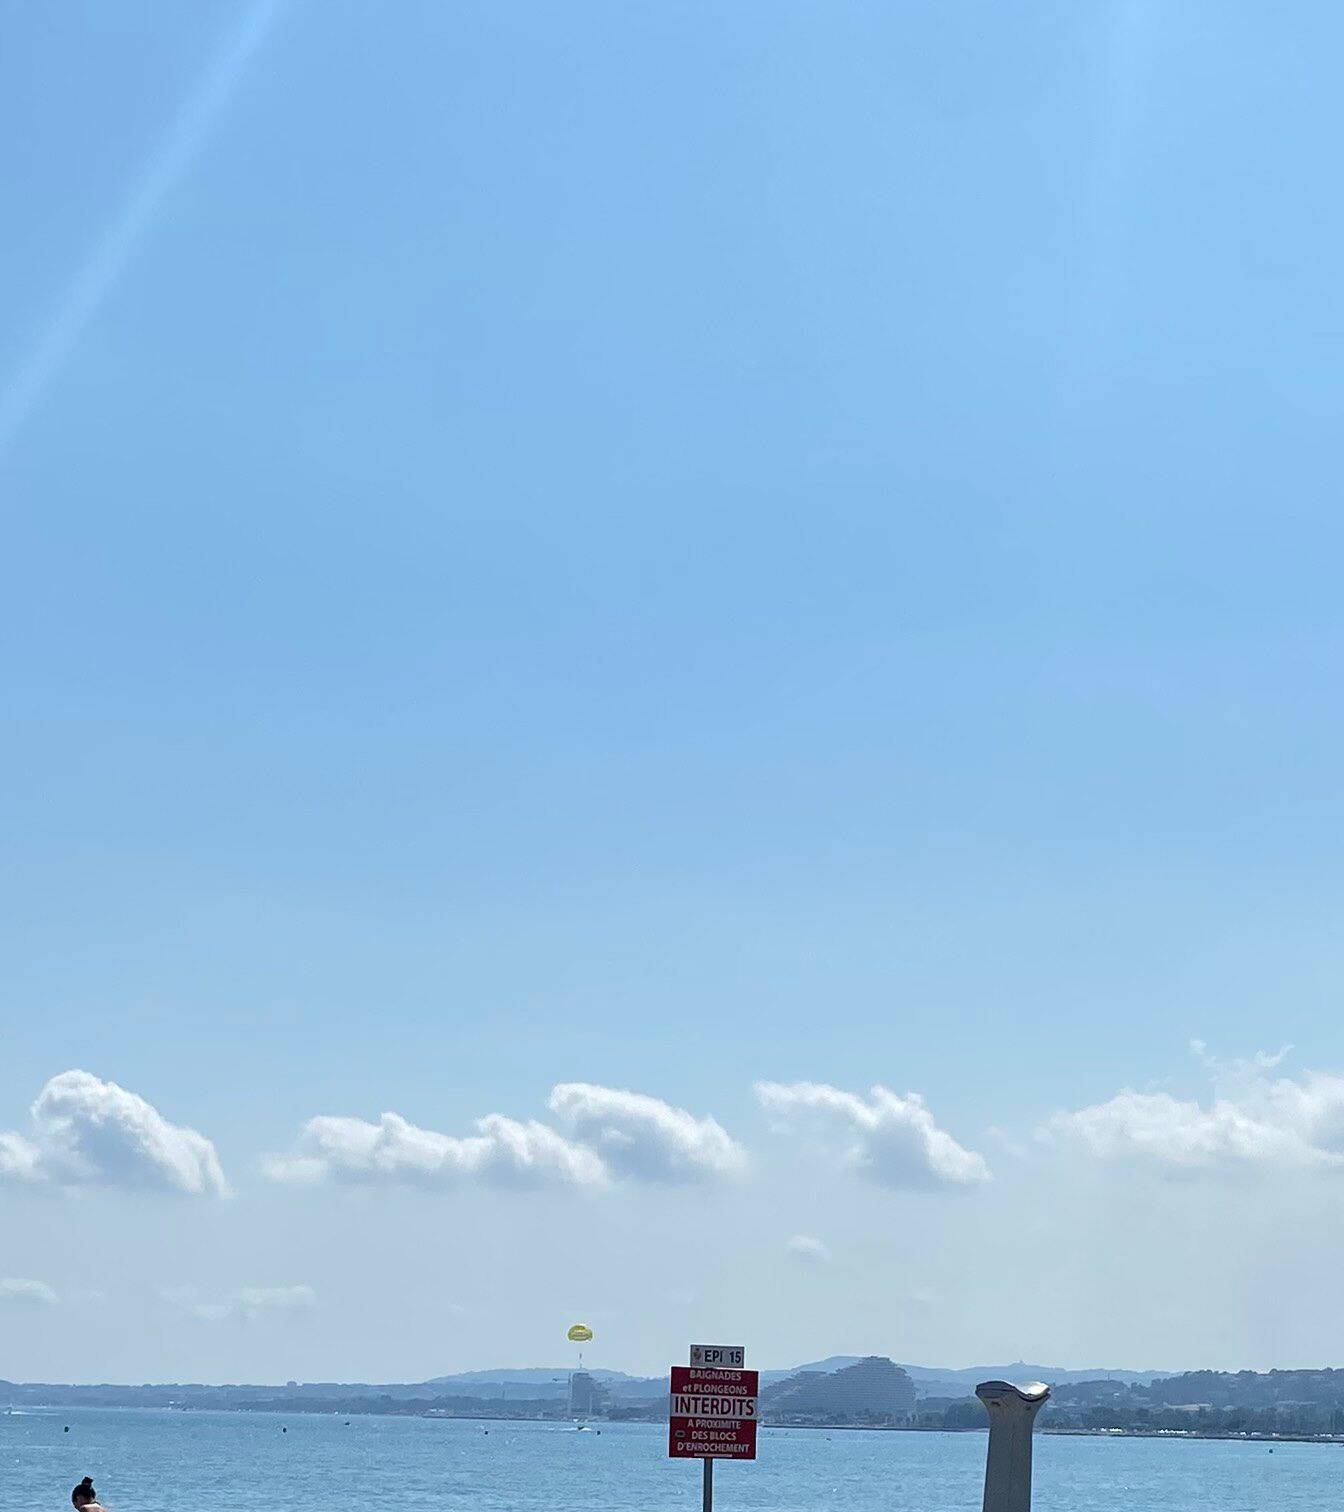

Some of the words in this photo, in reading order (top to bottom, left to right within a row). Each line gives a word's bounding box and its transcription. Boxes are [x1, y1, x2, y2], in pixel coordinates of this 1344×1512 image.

[704, 1349, 723, 1363] EPI
[729, 1351, 742, 1364] 15
[689, 1369, 742, 1381] BAIGNADES
[682, 1385, 692, 1393] et
[693, 1384, 748, 1395] PLONGEONS
[674, 1396, 755, 1416] INTERDITS
[691, 1431, 709, 1440] DES
[709, 1431, 737, 1441] BLOCS
